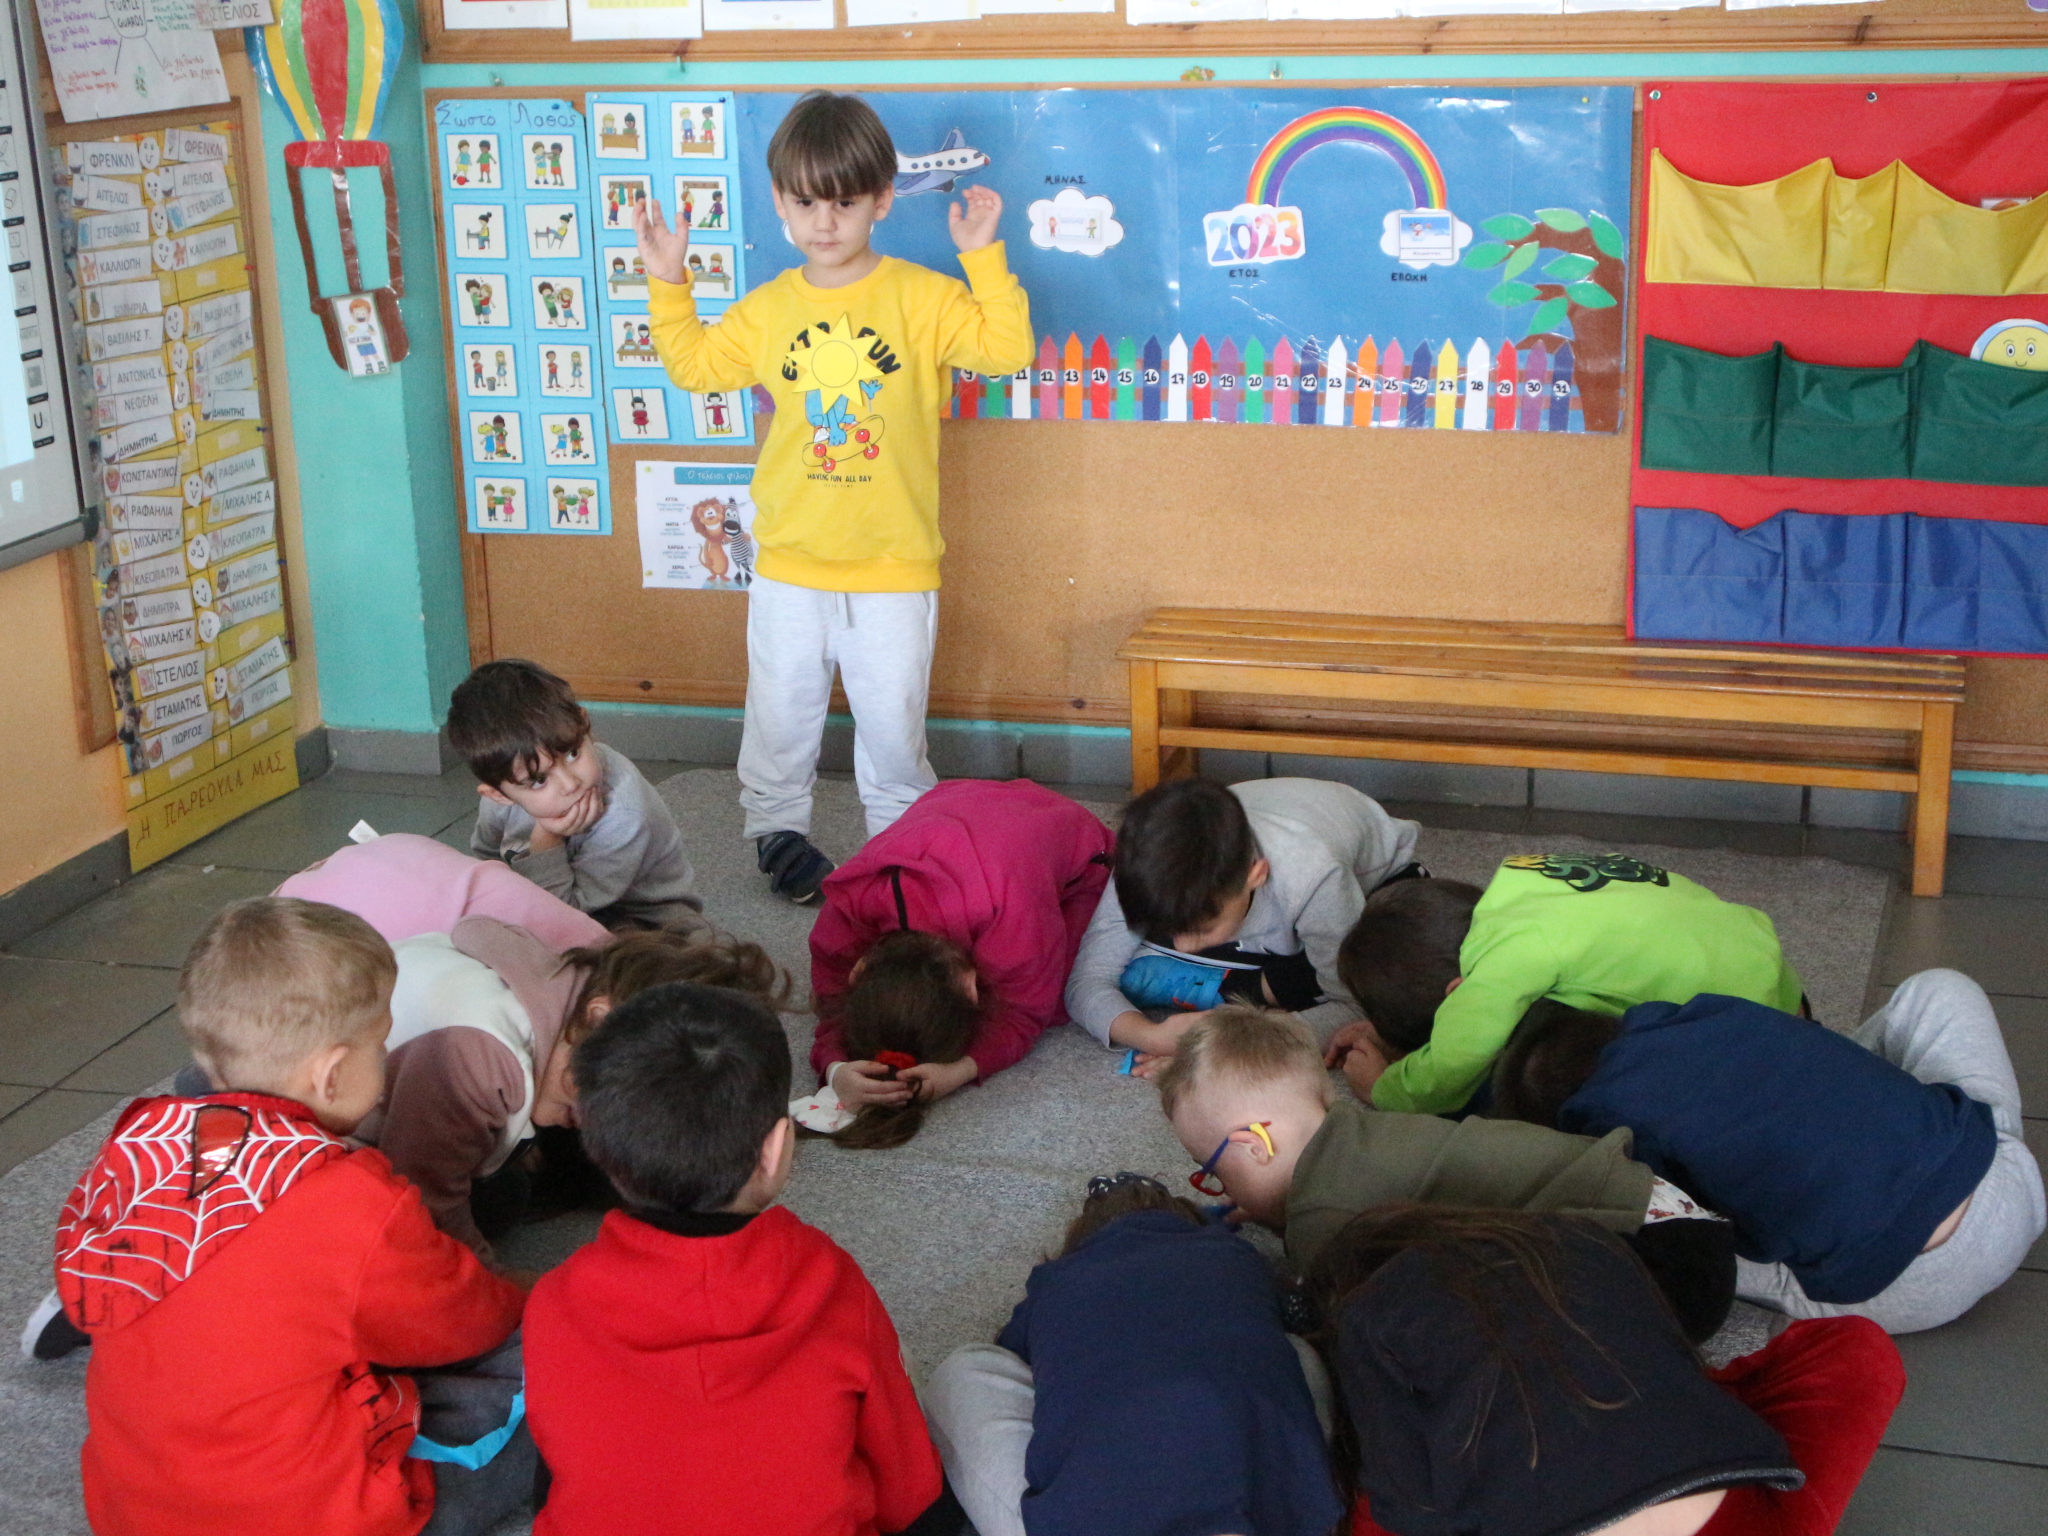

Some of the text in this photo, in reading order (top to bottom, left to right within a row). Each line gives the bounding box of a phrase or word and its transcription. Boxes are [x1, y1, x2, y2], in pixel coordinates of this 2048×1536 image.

[117, 14, 143, 27] GUARDS
[211, 3, 261, 22] ΣΤΕΛΙΟΣ
[184, 140, 223, 156] ΦΡΕΝΚΛΙ
[89, 153, 135, 168] ΦΡΕΝΚΛΙ
[182, 172, 213, 186] ΑΓΓΕΛΟΣ
[1045, 174, 1086, 185] ΜΗΝΑΣ
[96, 190, 129, 205] ΑΓΓΕΛΟΣ
[186, 191, 226, 218] ΣΤΕΦΑΝΟΣ
[96, 221, 141, 239] ΣΤΕΦΑΝΟΣ
[1207, 211, 1301, 262] 2023
[100, 258, 141, 274] ΚΑΛΛΙΟΠΗ
[1229, 268, 1260, 278] ΕΤΟΣ
[1391, 272, 1428, 282] ΕΠΟΧΗ
[107, 330, 142, 347] ΒΑΣΙΛΗΣ
[117, 367, 157, 384] ΑΝΤΩΝΗΣ
[215, 368, 243, 384] ΝΕΦΕΛΗ
[1041, 371, 1054, 382] 12
[1065, 370, 1079, 382] 13
[1093, 370, 1107, 381] 14
[1118, 371, 1132, 383] 15
[1144, 371, 1157, 382] 16
[1171, 373, 1185, 385] 17
[1193, 372, 1207, 384] 18
[1221, 374, 1234, 387] 19
[1248, 377, 1263, 387] 20
[1276, 378, 1290, 387] 21
[1302, 377, 1316, 387] 22
[1329, 377, 1342, 388] 23
[1358, 378, 1372, 388] 24
[1384, 379, 1399, 390] 25
[1413, 379, 1426, 390] 26
[1439, 380, 1454, 391] 27
[1470, 380, 1483, 391] 28
[1499, 382, 1512, 394] 29
[1527, 382, 1541, 393] 30
[1554, 383, 1568, 393] 31
[124, 395, 159, 411] ΝΕΦΕΛΗ
[212, 407, 245, 418] ΔΗΜΗΤΡΗΣ
[118, 433, 158, 457] ΔΗΜΗΤΡΗΣ
[121, 464, 178, 483] ΚΩΝΣΤΑΝΤΙΝΟΣ
[218, 458, 256, 478] ΡΑΦΑΗΛΙΑ
[807, 473, 829, 481] HAVING
[831, 474, 842, 482] FUN
[131, 504, 173, 516] ΡΑΦΑΗΛΙΑ
[225, 492, 262, 510] ΜΙΧΑΛΗΣ
[134, 531, 174, 550] ΜΙΧΑΛΗΣ
[222, 525, 266, 550] ΚΛΕΟΠΑΤΡΑ
[134, 567, 180, 585] ΚΛΕΟΠΑΤΡΑ
[142, 601, 180, 618] ΔΗΜΗΤΡΑ
[231, 592, 269, 613] ΜΙΧΑΛΗΣ
[143, 628, 185, 648] ΜΙΧΑΛΗΣ
[155, 660, 199, 685] ΣΤΕΛΙΟΣ
[237, 646, 280, 683] ΣΤΑΜΑΤΗΣ
[156, 694, 202, 720] ΣΤΑΜΑΤΗΣ
[171, 724, 203, 746] ΓΙΩΡΓΟΣ
[163, 768, 244, 829] ΠΑΡΕΟΥΛΑ
[252, 750, 287, 781] ΜΑΣ
